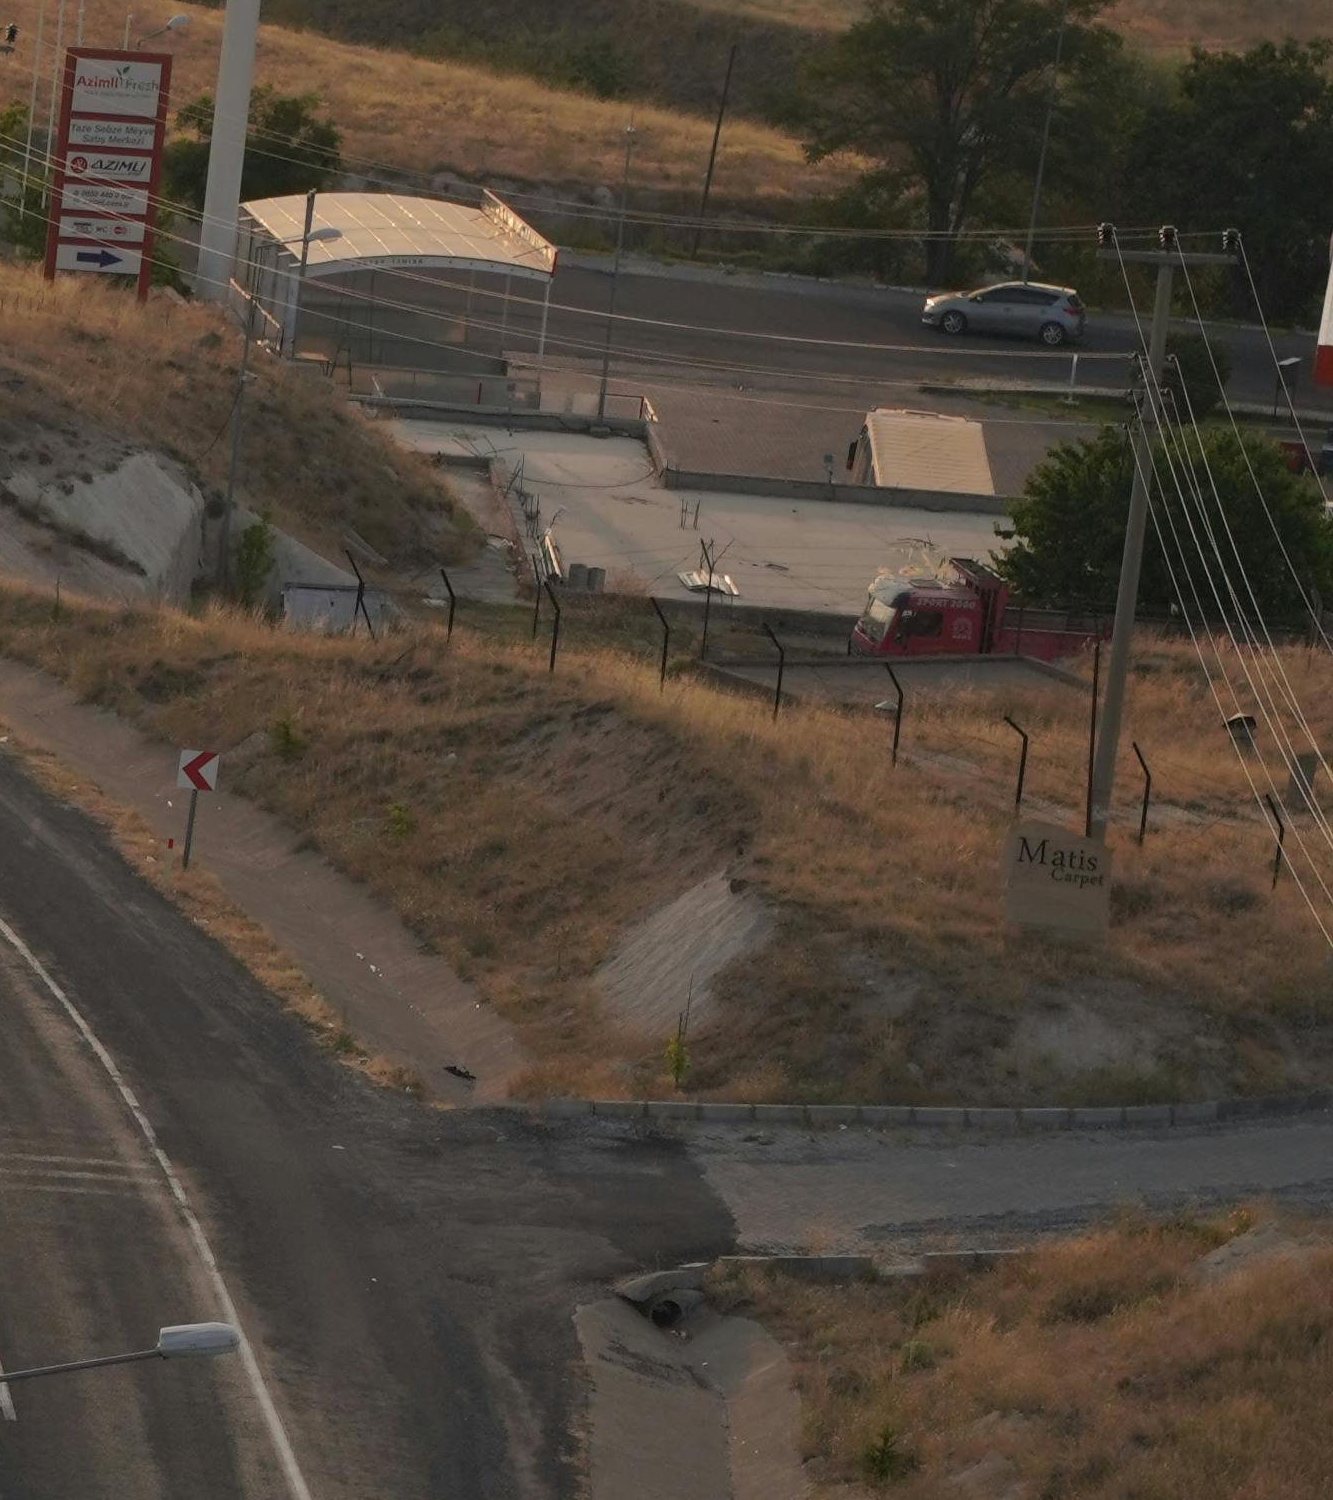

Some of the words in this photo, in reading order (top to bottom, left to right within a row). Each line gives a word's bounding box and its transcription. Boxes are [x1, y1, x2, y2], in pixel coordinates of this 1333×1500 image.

[125, 79, 159, 92] Fresh
[1017, 836, 1098, 872] Matis
[1051, 867, 1103, 889] Carpet
